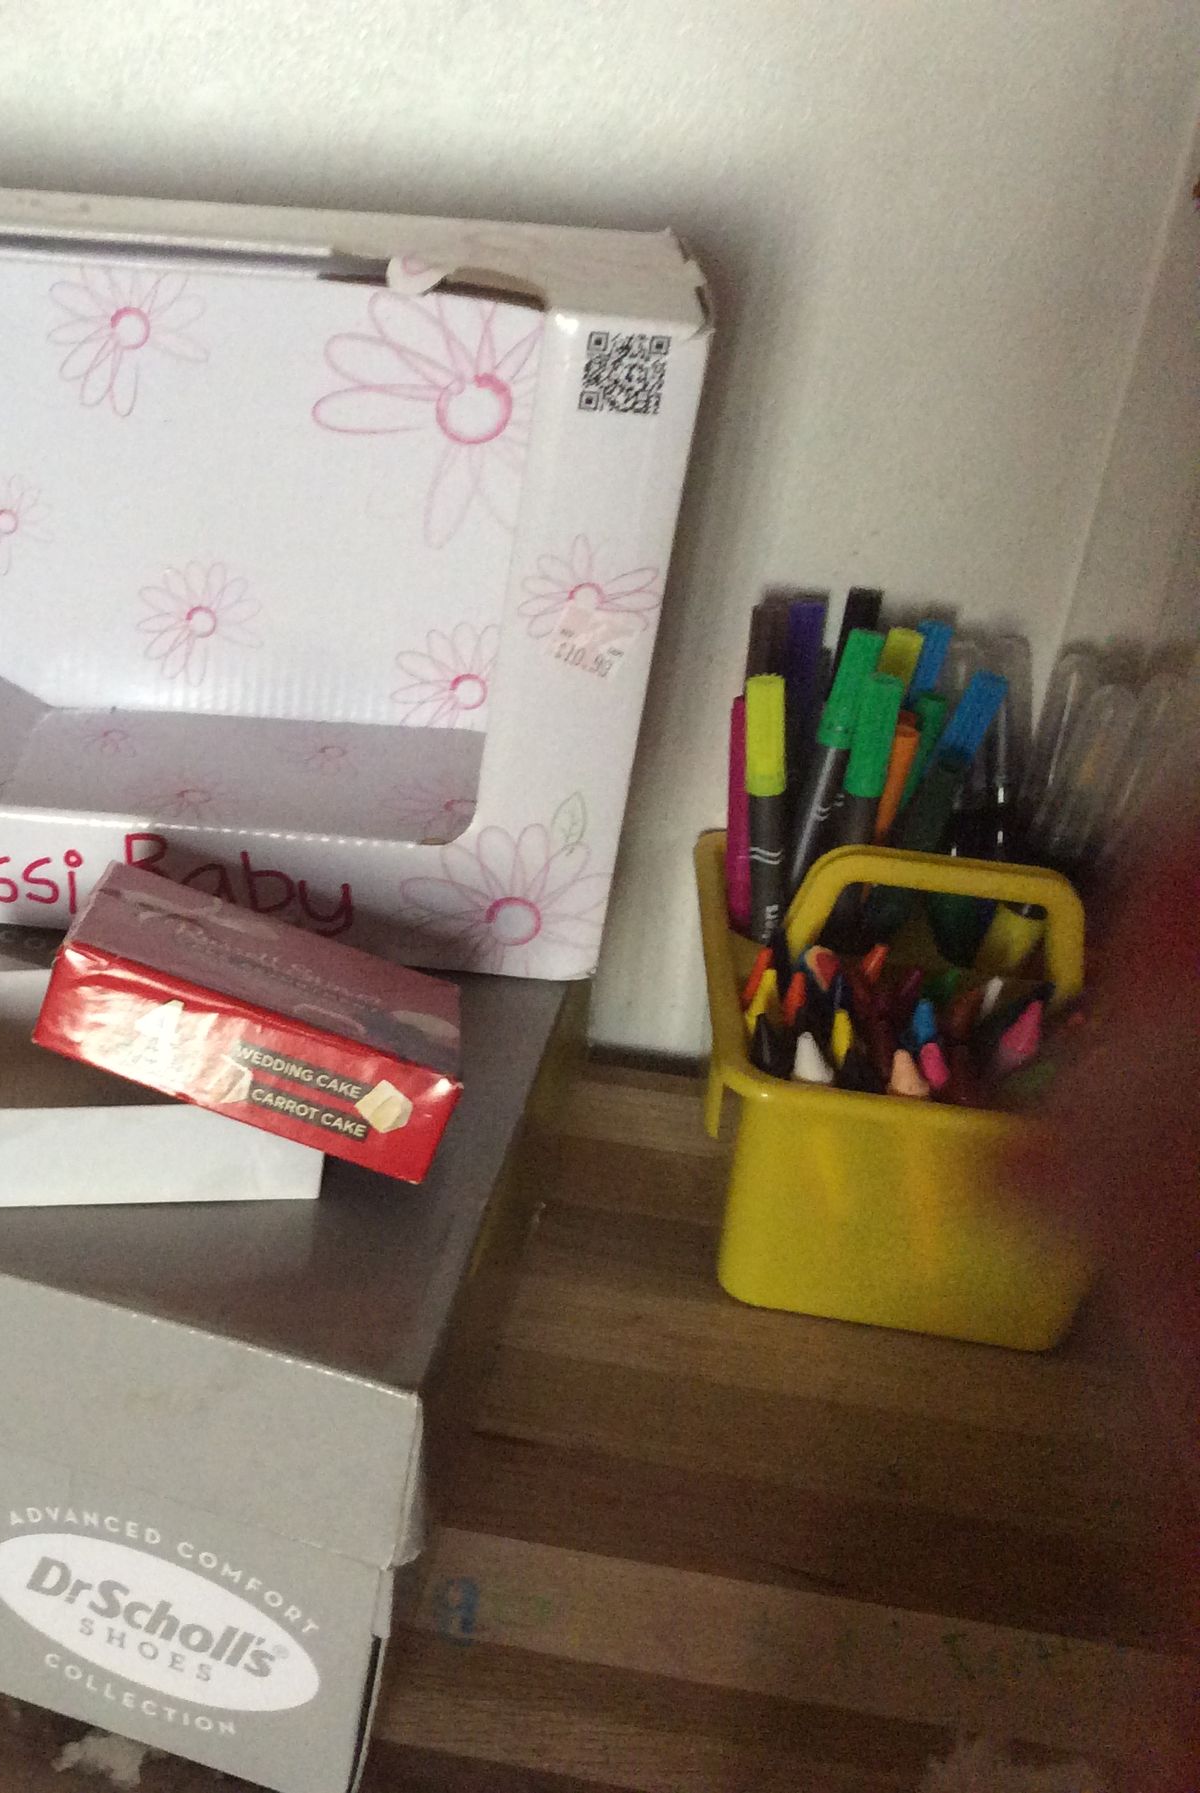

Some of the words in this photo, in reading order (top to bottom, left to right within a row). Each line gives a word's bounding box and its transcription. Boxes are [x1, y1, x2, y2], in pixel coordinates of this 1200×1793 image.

[236, 1047, 314, 1082] WEDDING
[315, 1074, 362, 1099] CAKE
[251, 1088, 320, 1120] CARROT
[321, 1112, 367, 1138] CAKE
[8, 1506, 162, 1546] ADVANCED
[176, 1541, 320, 1635] COMFORT
[78, 1617, 213, 1683] SHOES
[44, 1652, 238, 1736] COLLECTION
